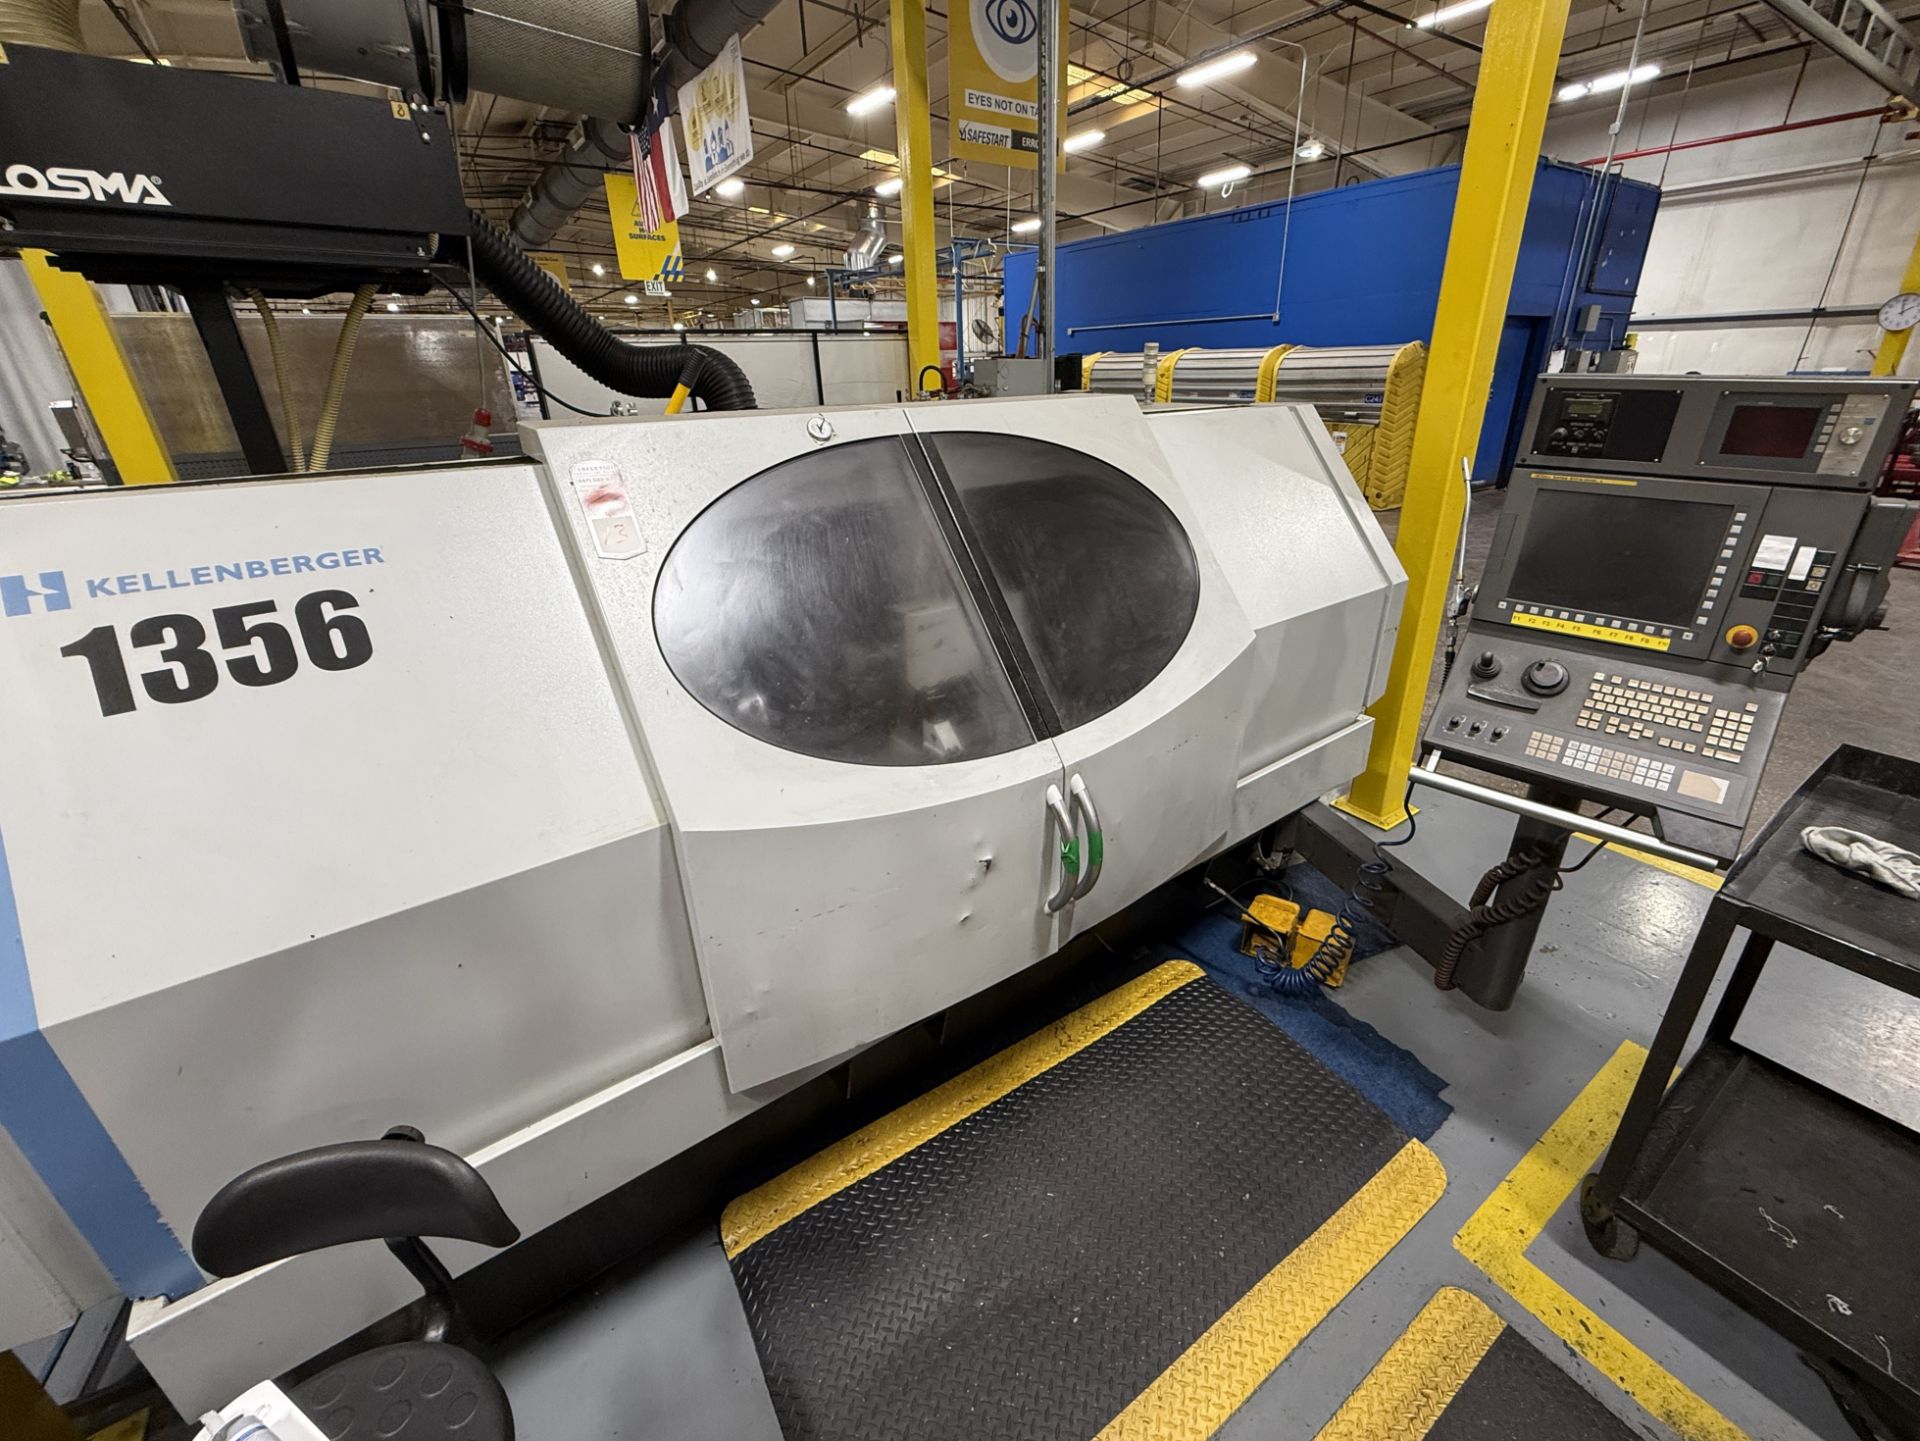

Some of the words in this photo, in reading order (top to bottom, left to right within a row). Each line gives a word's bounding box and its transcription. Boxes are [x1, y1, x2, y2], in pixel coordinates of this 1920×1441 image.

[968, 92, 993, 109] EYES
[994, 99, 1013, 112] NOT
[1015, 102, 1028, 114] ON
[967, 128, 1010, 148] SAFESTART
[628, 232, 666, 241] SURFACES
[646, 281, 665, 293] EXIT
[86, 547, 385, 599] KELLENBERGER
[59, 588, 374, 718] 1356
